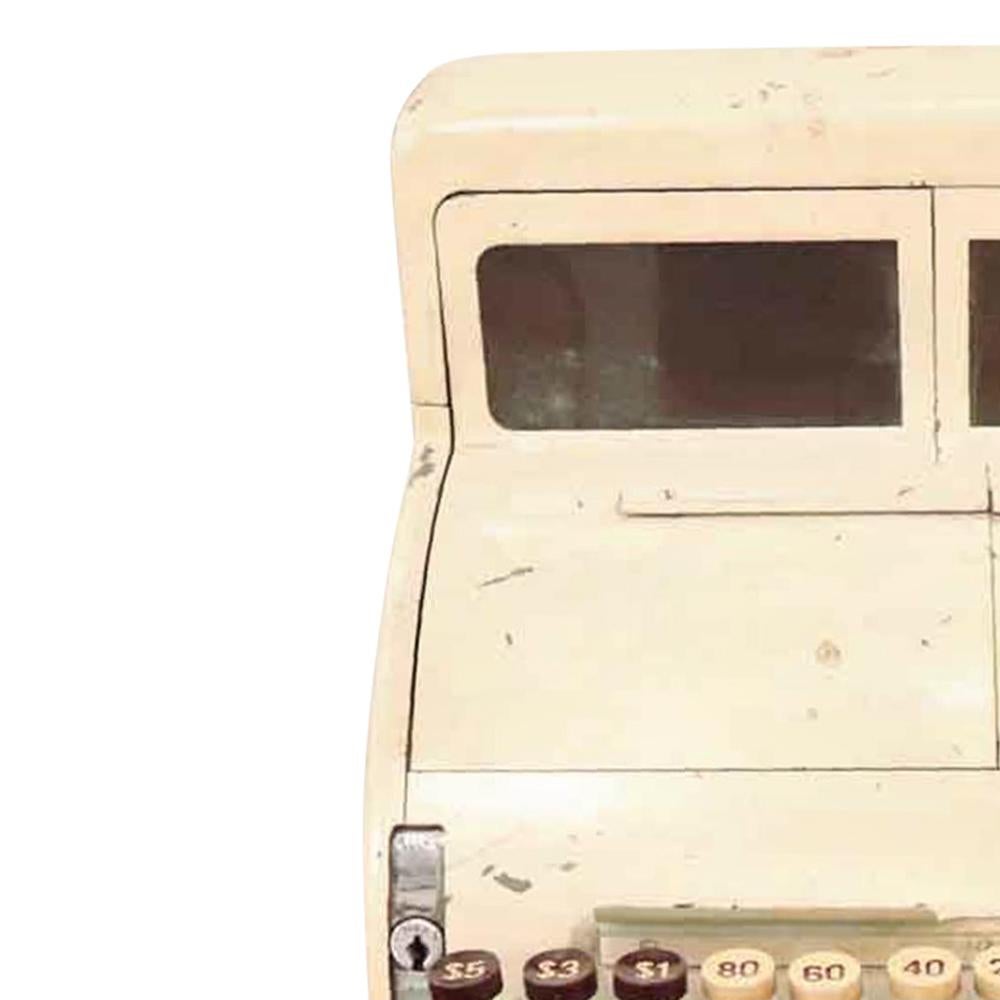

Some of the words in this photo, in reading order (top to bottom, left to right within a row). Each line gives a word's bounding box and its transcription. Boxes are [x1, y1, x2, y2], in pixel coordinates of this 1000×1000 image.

[442, 960, 486, 980] $5
[536, 960, 580, 979] $3
[634, 960, 671, 980] $1
[717, 961, 760, 976] 80
[802, 965, 846, 982] 60
[904, 959, 944, 975] 40
